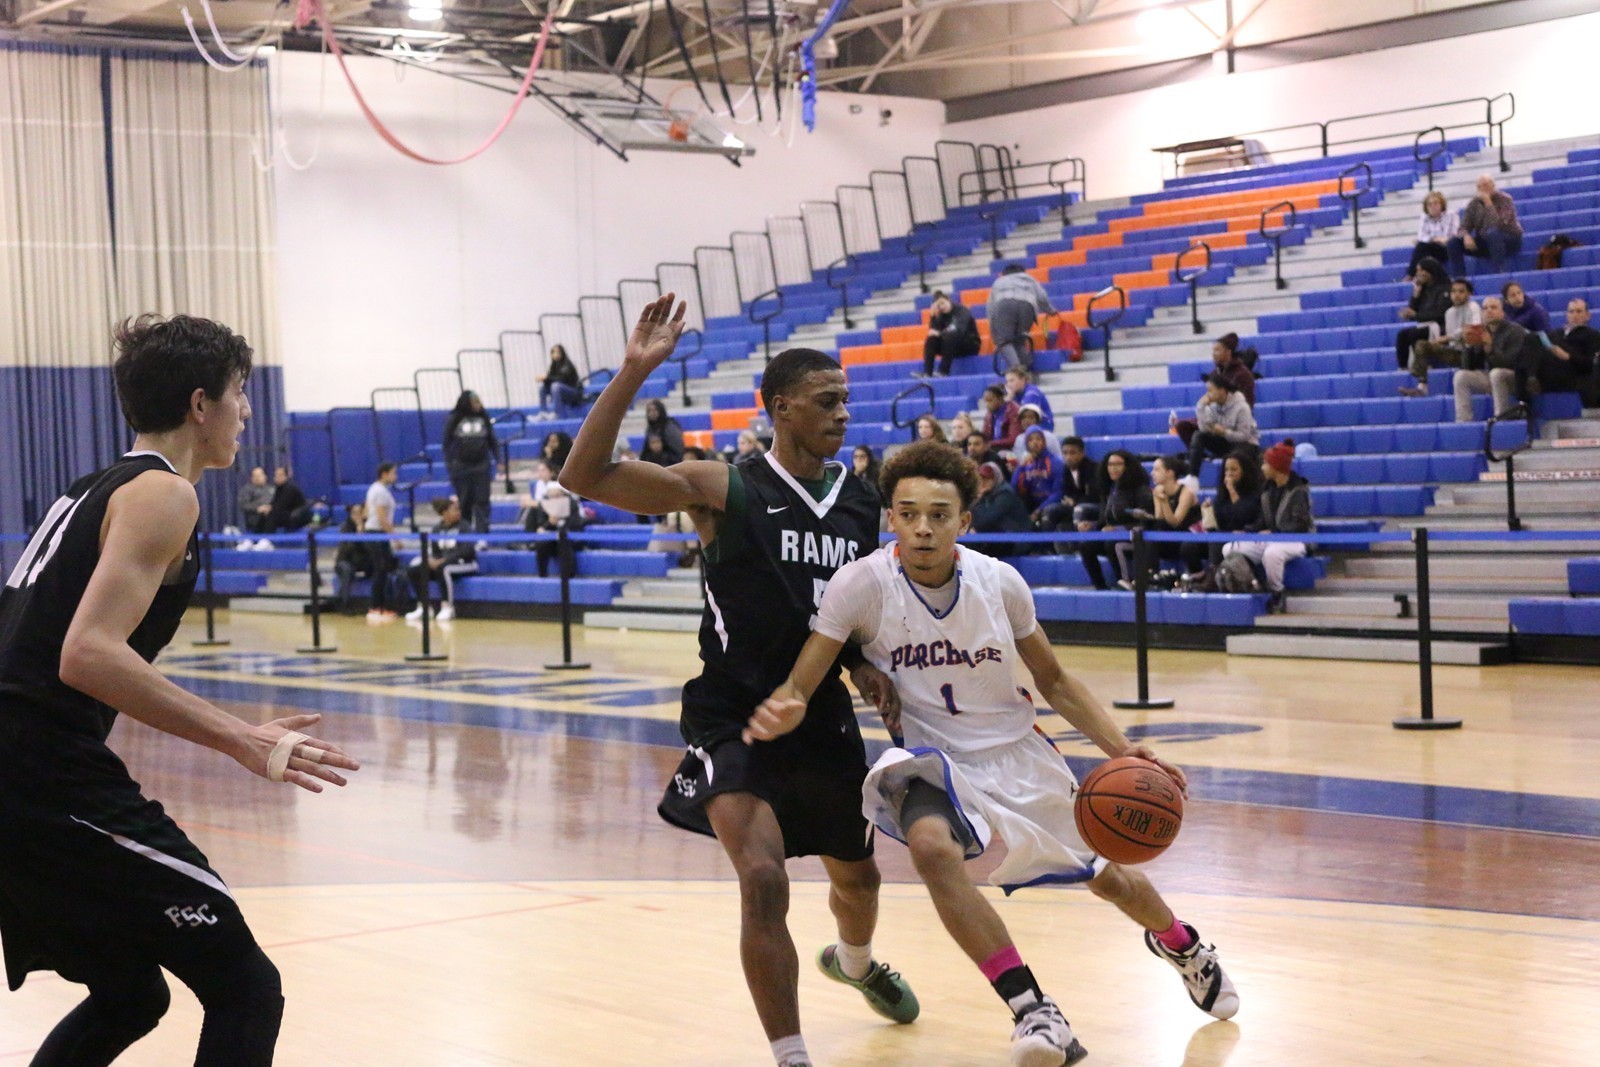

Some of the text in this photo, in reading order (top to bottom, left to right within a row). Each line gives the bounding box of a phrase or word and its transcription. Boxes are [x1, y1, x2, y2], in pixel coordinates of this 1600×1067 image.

[781, 529, 859, 568] RAMS
[940, 683, 962, 716] 1
[1113, 804, 1153, 835] ROCK
[164, 903, 218, 928] FSC
